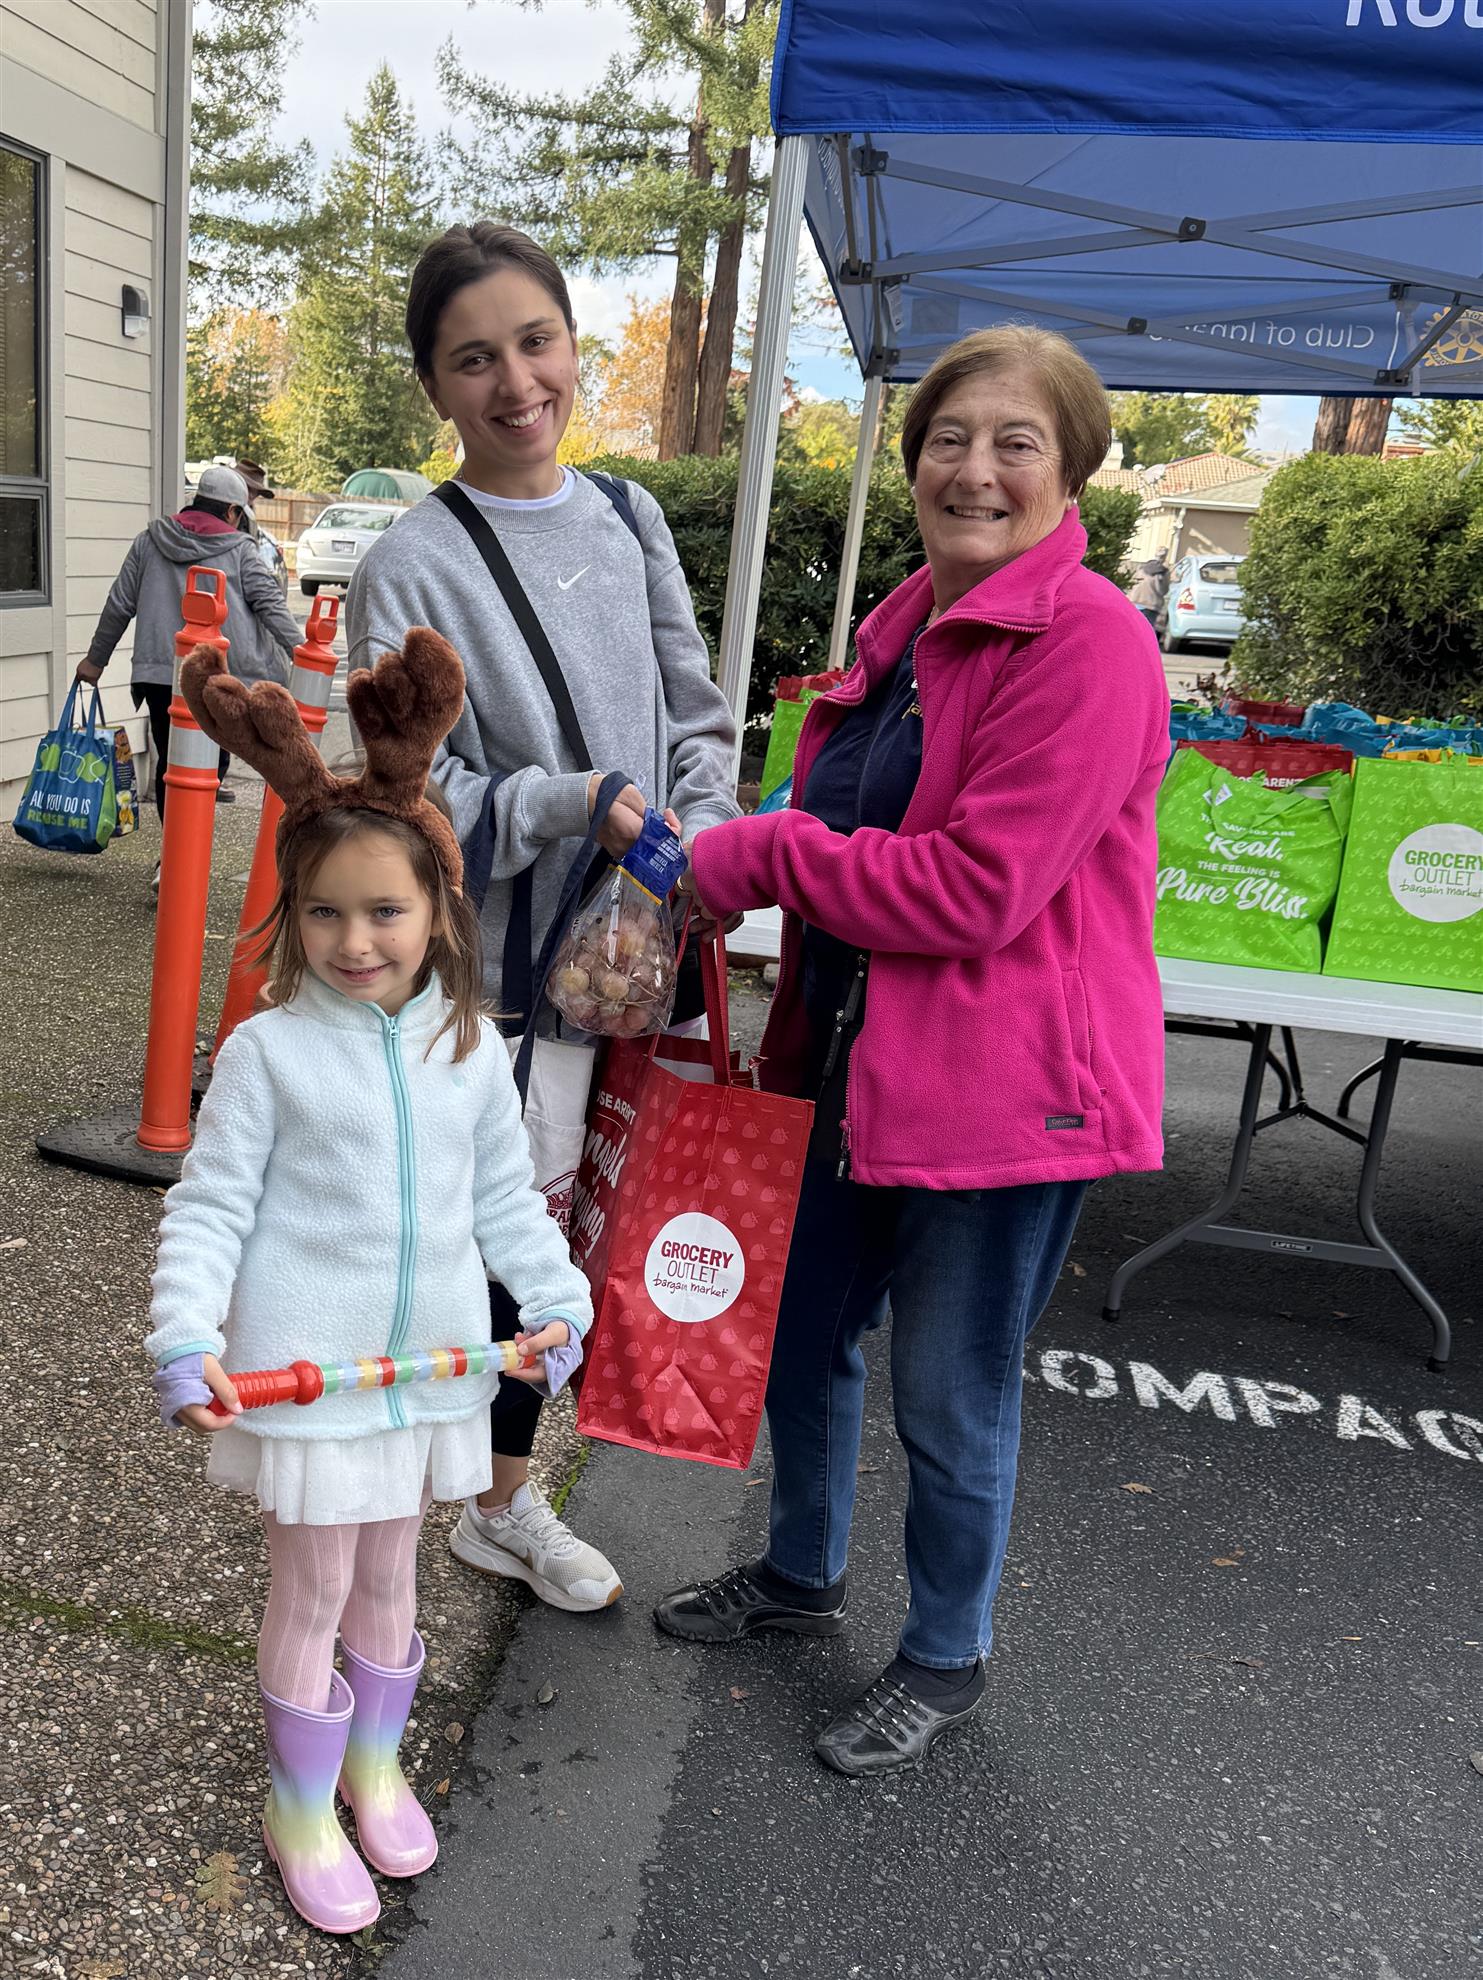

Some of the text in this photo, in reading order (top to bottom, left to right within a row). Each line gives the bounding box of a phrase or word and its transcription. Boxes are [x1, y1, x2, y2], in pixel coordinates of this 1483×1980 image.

[64, 798, 78, 813] DO
[80, 799, 90, 814] IS
[69, 818, 88, 829] ME
[1198, 860, 1281, 878] THE FEELING IS
[1414, 867, 1475, 886] OUTLET
[1156, 866, 1229, 904] Pure
[1399, 878, 1444, 897] bargain
[661, 1240, 734, 1268] GROCERY
[667, 1260, 719, 1284] OUTLET
[653, 1272, 728, 1298] bargain market
[1022, 1350, 1483, 1463] OMPAC
